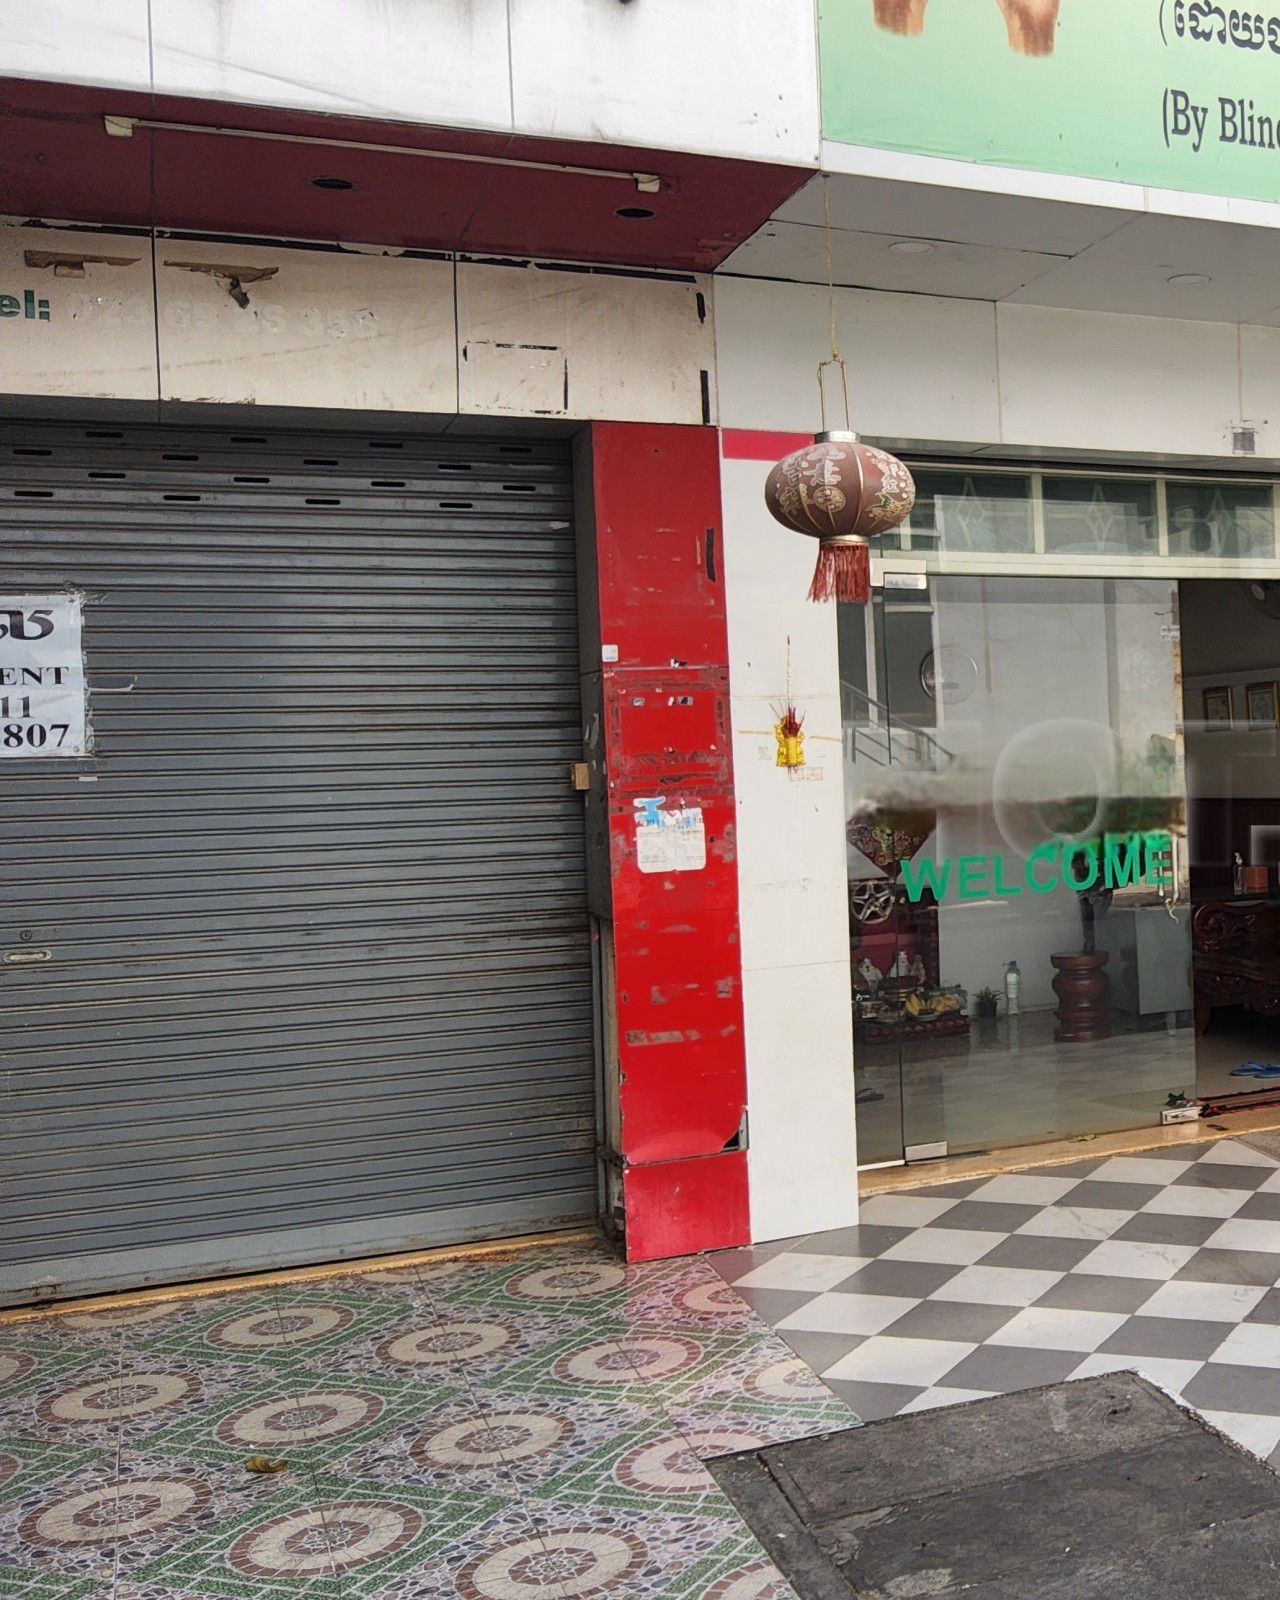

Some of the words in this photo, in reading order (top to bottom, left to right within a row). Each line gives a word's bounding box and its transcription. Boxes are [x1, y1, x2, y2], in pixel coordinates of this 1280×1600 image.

[1163, 87, 1208, 153] (By
[0, 289, 50, 322] el:
[0, 667, 69, 686] ENT
[900, 829, 1176, 902] WELCOME
